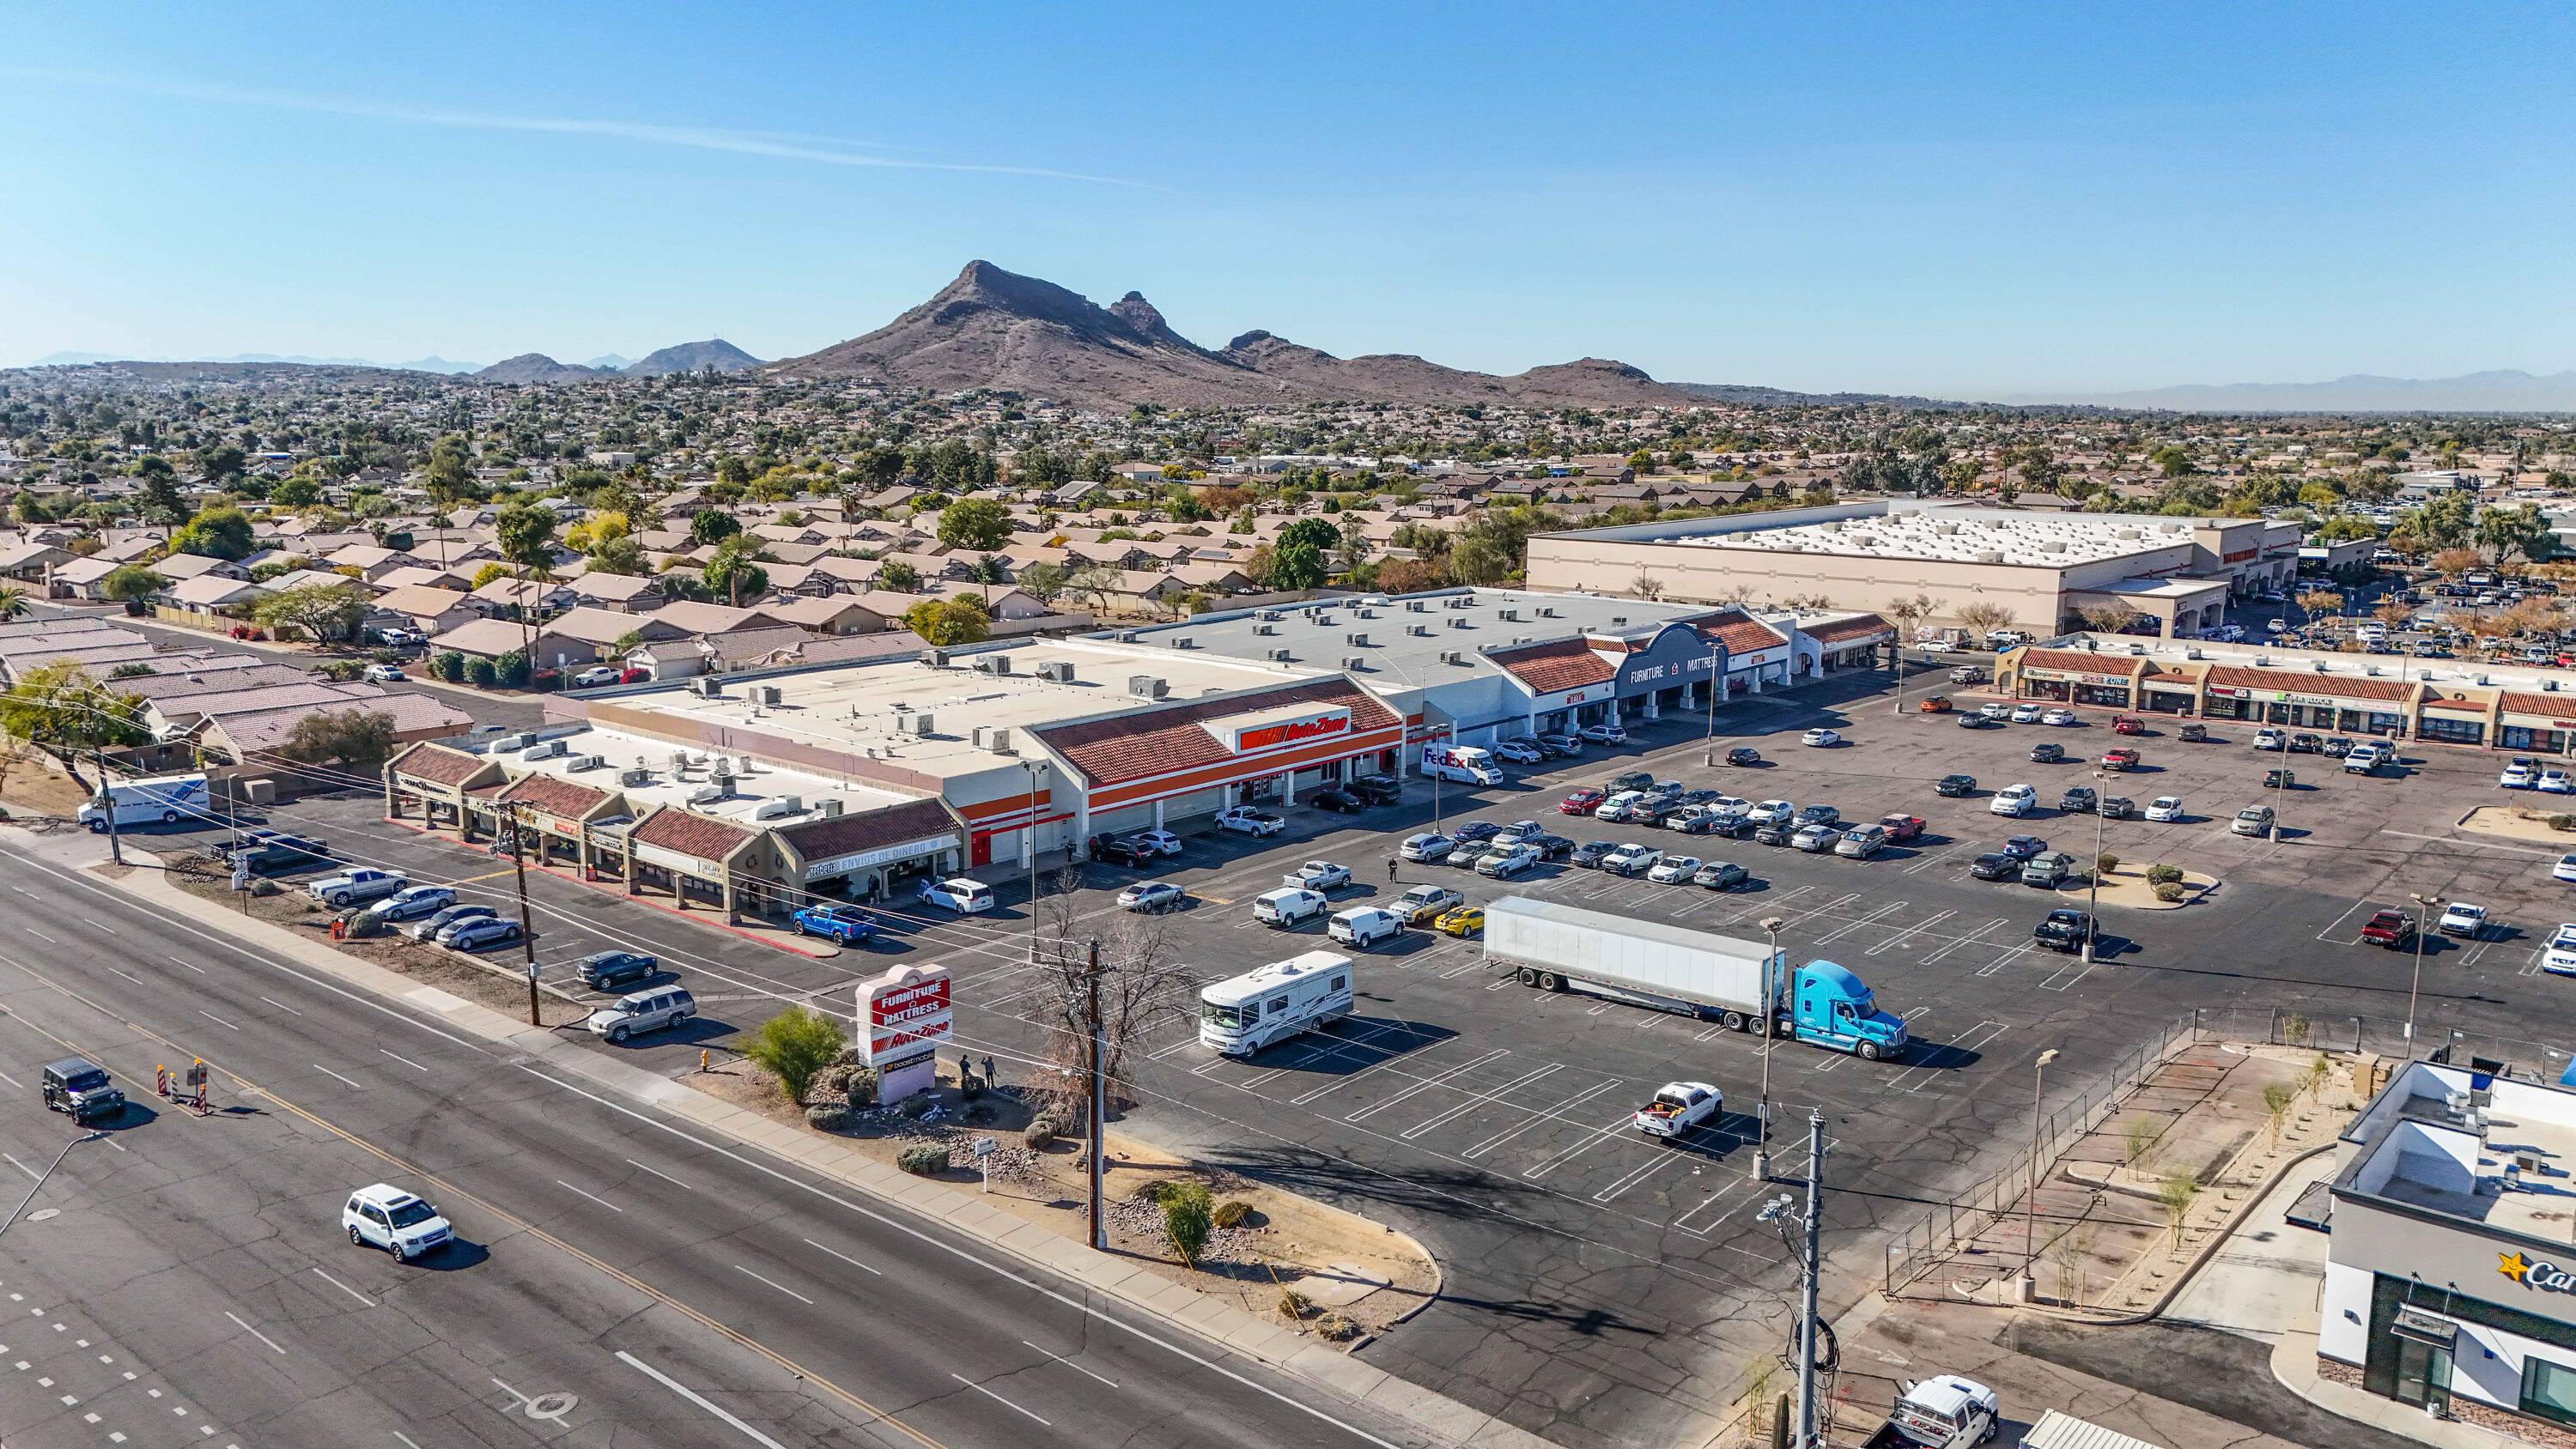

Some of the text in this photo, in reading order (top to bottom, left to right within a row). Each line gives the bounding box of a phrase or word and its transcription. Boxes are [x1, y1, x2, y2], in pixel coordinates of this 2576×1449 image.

[1631, 655, 1717, 684] FURNITURE MATTRESS
[2105, 676, 2129, 686] ZONE
[2305, 696, 2333, 706] BLOCK
[1285, 717, 1348, 742] AutoZone
[1424, 748, 1466, 769] FedEx
[842, 853, 876, 870] ENVIOS
[878, 850, 890, 861] DE
[893, 843, 926, 858] DINERO
[881, 981, 942, 1009] FURNITURE
[883, 1000, 939, 1027] MATTRESS
[890, 1021, 950, 1048] AutoZone
